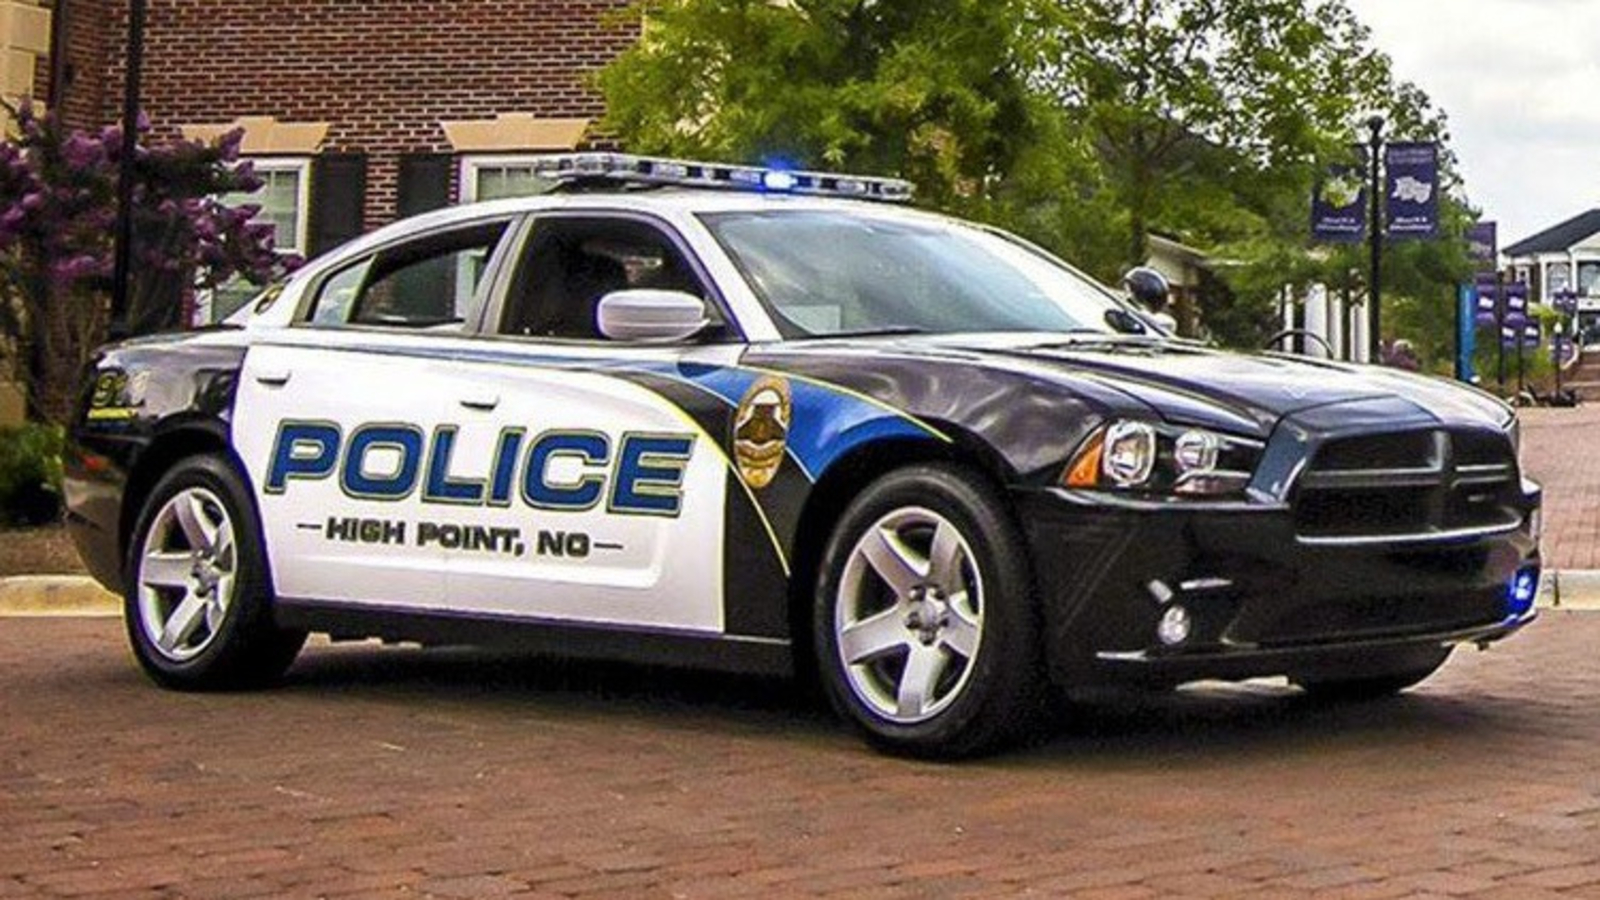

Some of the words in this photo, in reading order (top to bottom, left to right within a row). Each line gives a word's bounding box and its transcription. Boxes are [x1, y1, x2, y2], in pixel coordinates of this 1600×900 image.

[263, 418, 699, 518] POLICE
[326, 517, 405, 545] HIGH
[416, 521, 525, 556] POINT,
